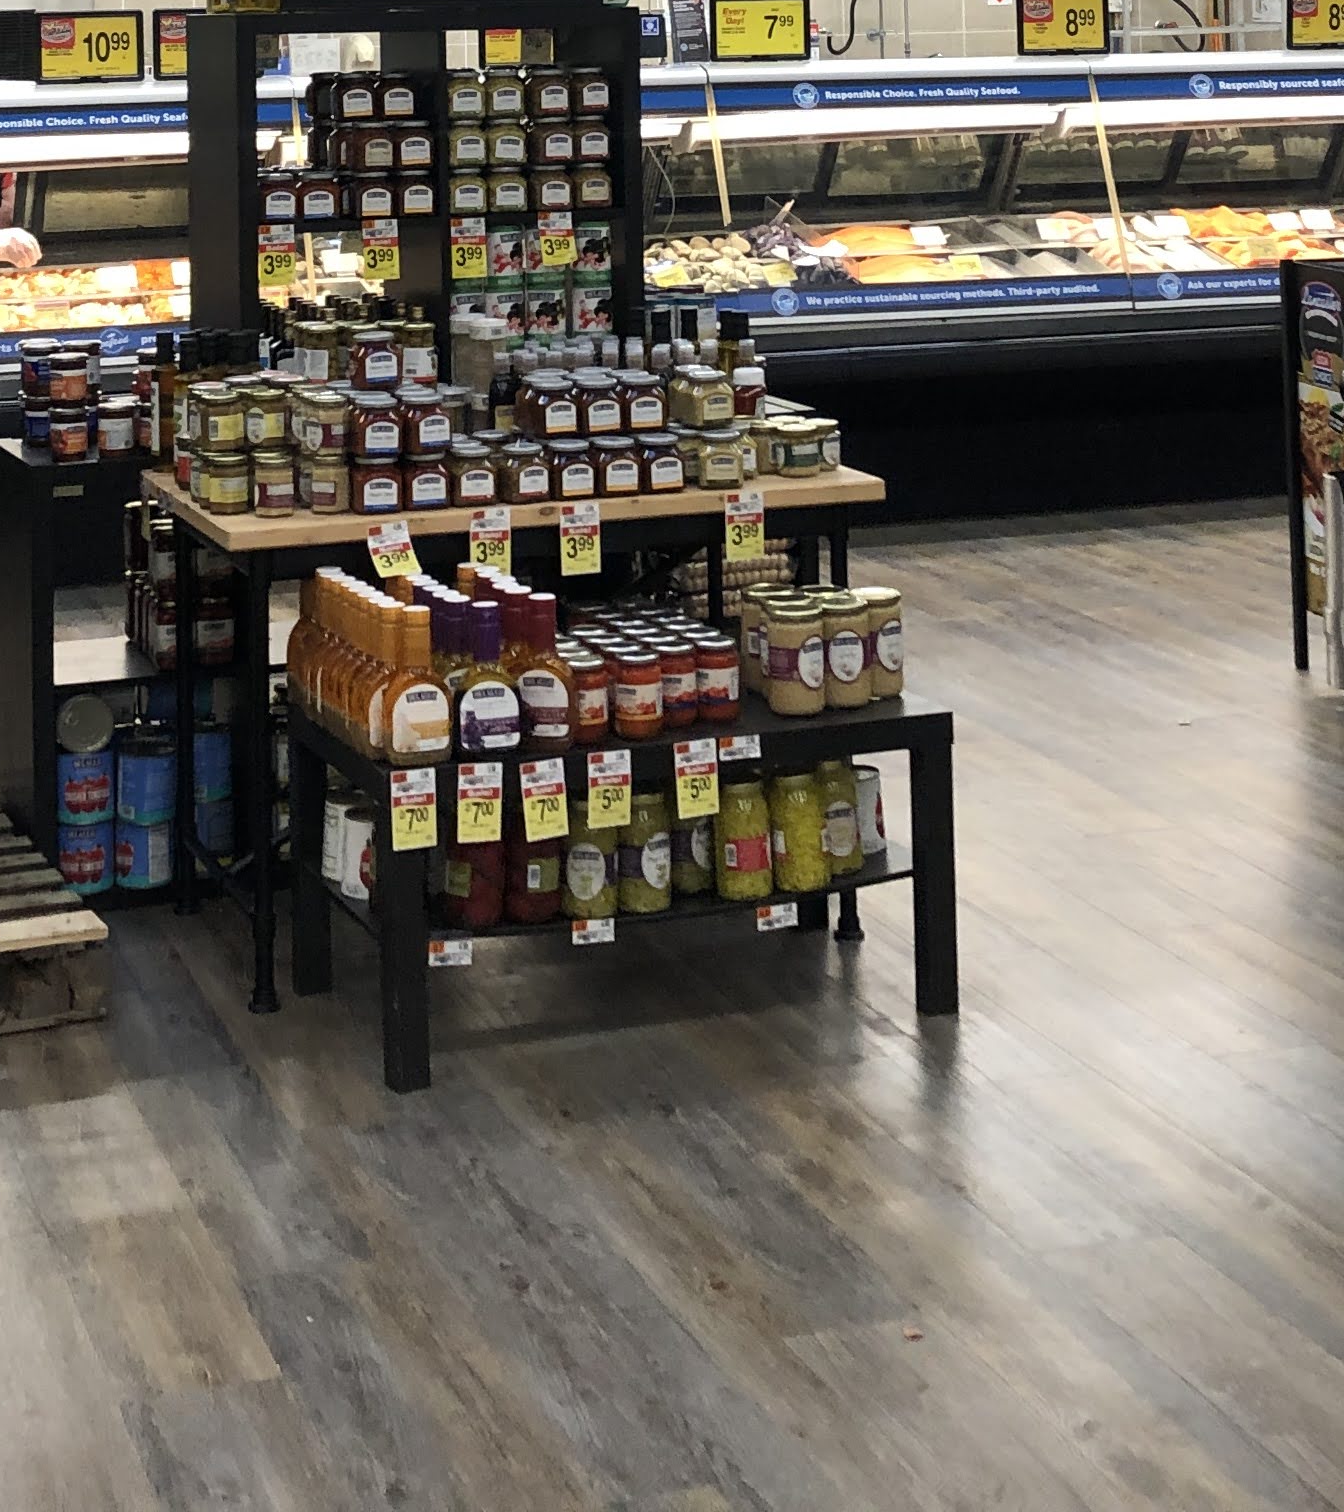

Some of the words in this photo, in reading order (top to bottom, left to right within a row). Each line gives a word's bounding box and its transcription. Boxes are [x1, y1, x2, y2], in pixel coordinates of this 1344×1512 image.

[723, 7, 746, 18] Every
[1219, 80, 1278, 92] Responsibly
[1280, 78, 1319, 89] sourced
[825, 88, 881, 100] Responsible
[883, 89, 917, 98] Choice.
[919, 88, 943, 97] Fresh
[946, 87, 978, 97] Quality
[981, 86, 1020, 96] Seafood.
[46, 116, 86, 127] Choice.
[90, 114, 118, 125] Fresh
[122, 113, 160, 125] Quality
[163, 112, 188, 123] Seaf
[806, 296, 822, 305] We
[824, 295, 862, 306] practice
[865, 292, 918, 303] sustainable
[921, 291, 961, 302] sourcing
[963, 288, 1005, 298] methods.
[1008, 285, 1060, 297] Third-party
